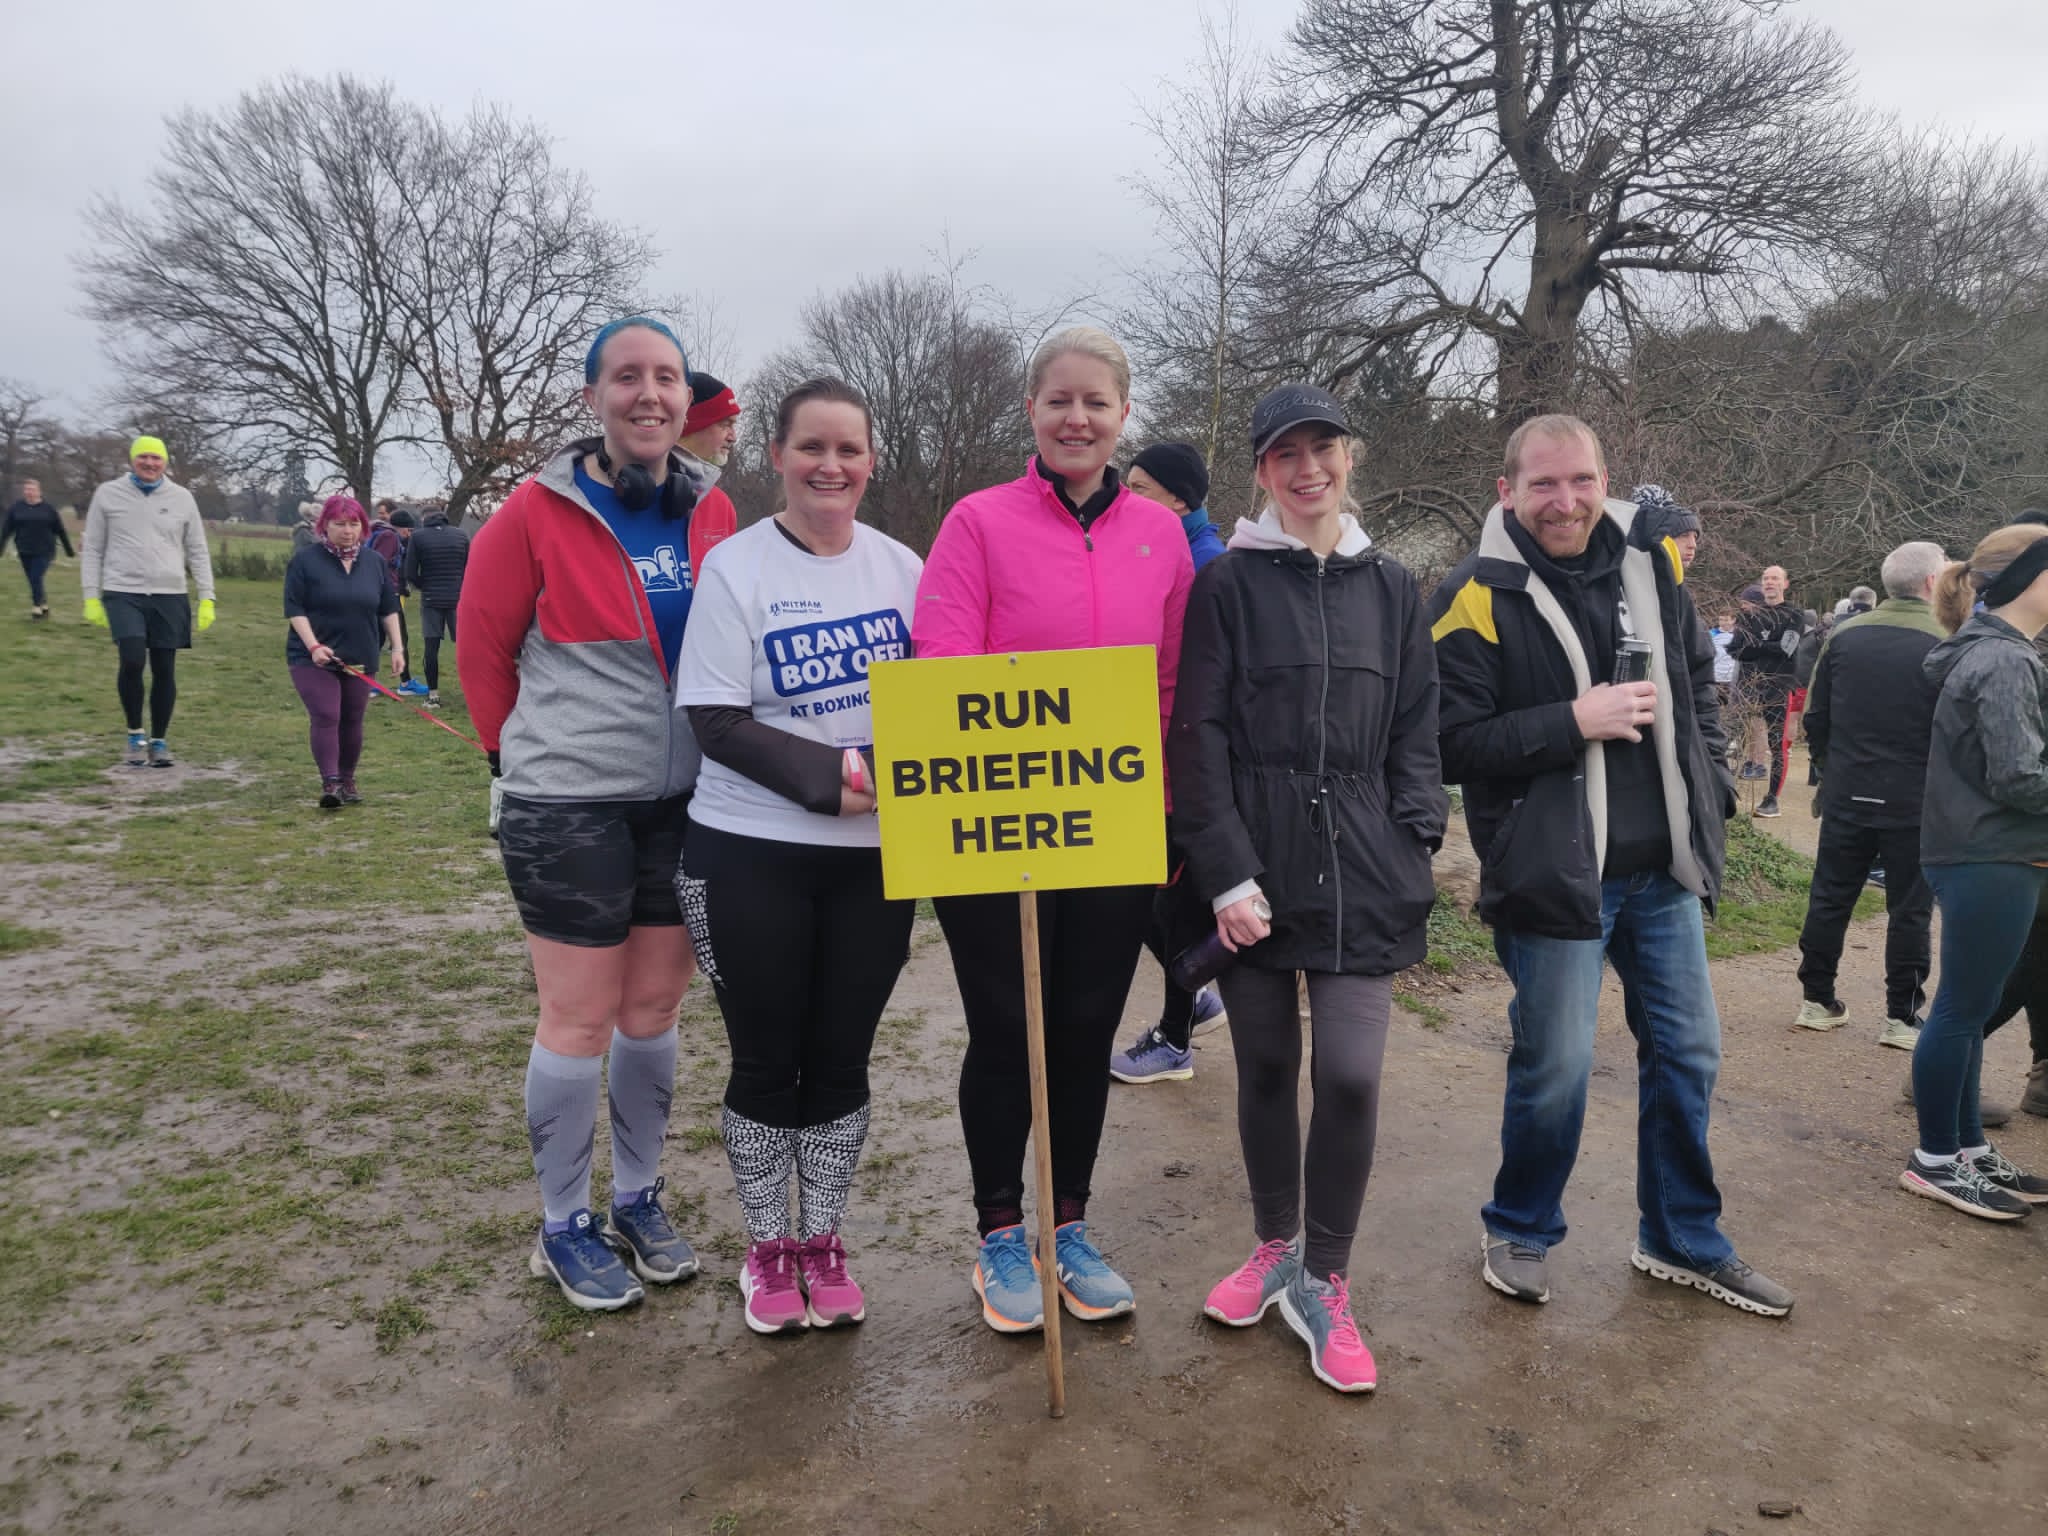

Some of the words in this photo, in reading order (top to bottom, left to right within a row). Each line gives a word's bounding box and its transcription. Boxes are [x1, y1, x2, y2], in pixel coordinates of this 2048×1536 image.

[780, 600, 823, 609] WITHAM
[773, 639, 786, 664] I
[791, 625, 860, 660] RAN
[862, 616, 898, 644] MY
[780, 653, 848, 690] BOX
[790, 704, 809, 719] AT
[957, 687, 1071, 732] RUN
[892, 745, 1145, 797] BRIEFING
[952, 810, 1094, 855] HERE
